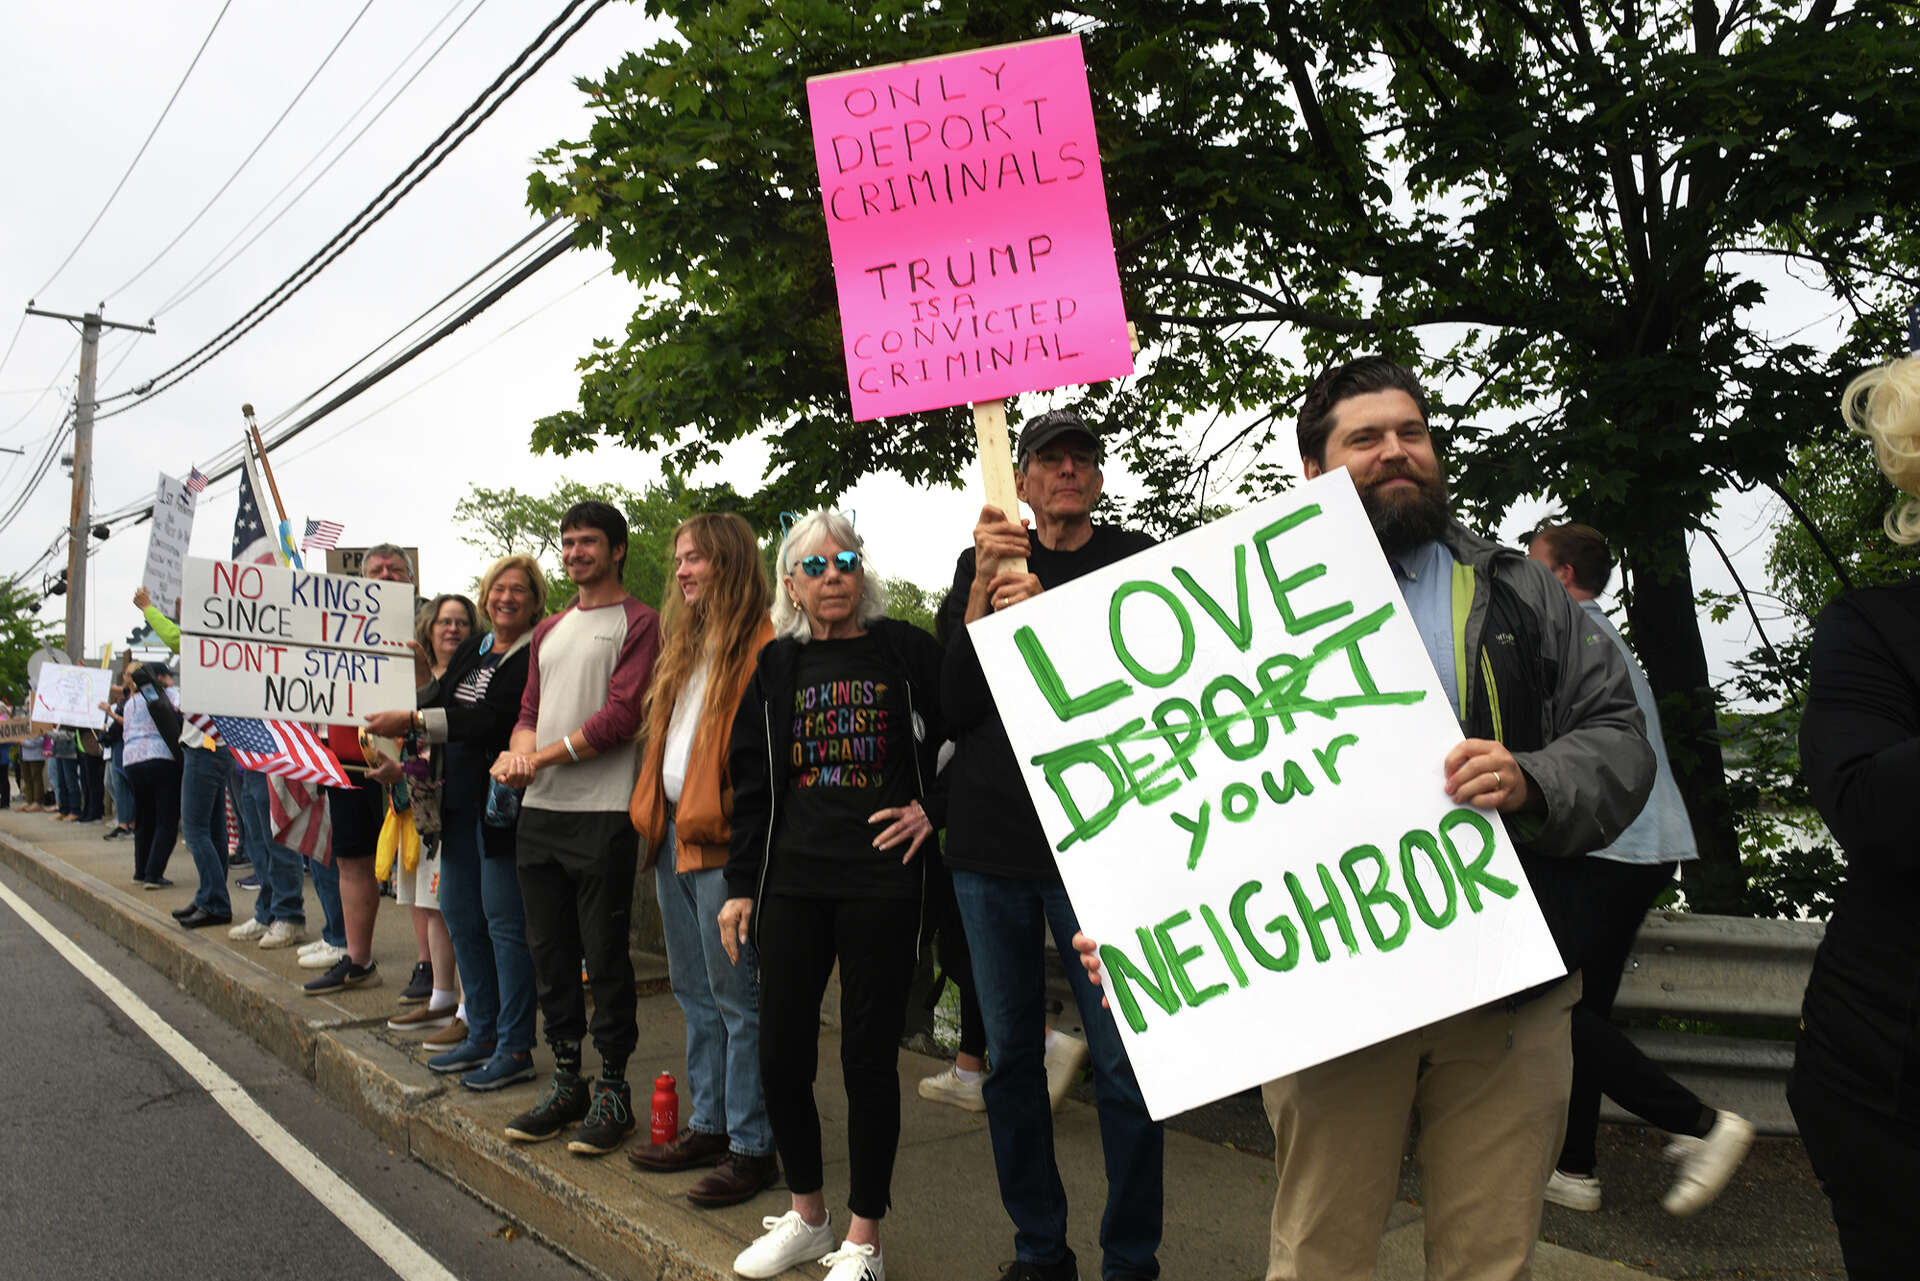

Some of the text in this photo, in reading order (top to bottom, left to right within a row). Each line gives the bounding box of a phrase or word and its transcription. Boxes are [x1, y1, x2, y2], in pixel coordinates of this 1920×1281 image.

[845, 63, 1006, 117] ONLY
[832, 98, 1047, 174] DEPORT
[831, 142, 1085, 222] CRIMINALS
[865, 235, 1052, 300] TRUMP
[854, 298, 1076, 360] CONVICTED
[910, 294, 975, 323] IS A
[858, 333, 1084, 394] CRIMINAL
[213, 561, 263, 600] NO
[291, 571, 382, 614] KINGS
[1014, 504, 1354, 722] LOVE
[203, 597, 293, 638] SINCE
[304, 649, 389, 684] START
[795, 680, 874, 713] NO KINGS
[805, 707, 888, 737] FASCISTS
[793, 735, 887, 767] O TYRANTS
[1032, 603, 1412, 848] DEPORT
[819, 764, 867, 788] NAZIS
[1171, 733, 1359, 870] your
[1099, 808, 1520, 1035] NEIGHBOR
